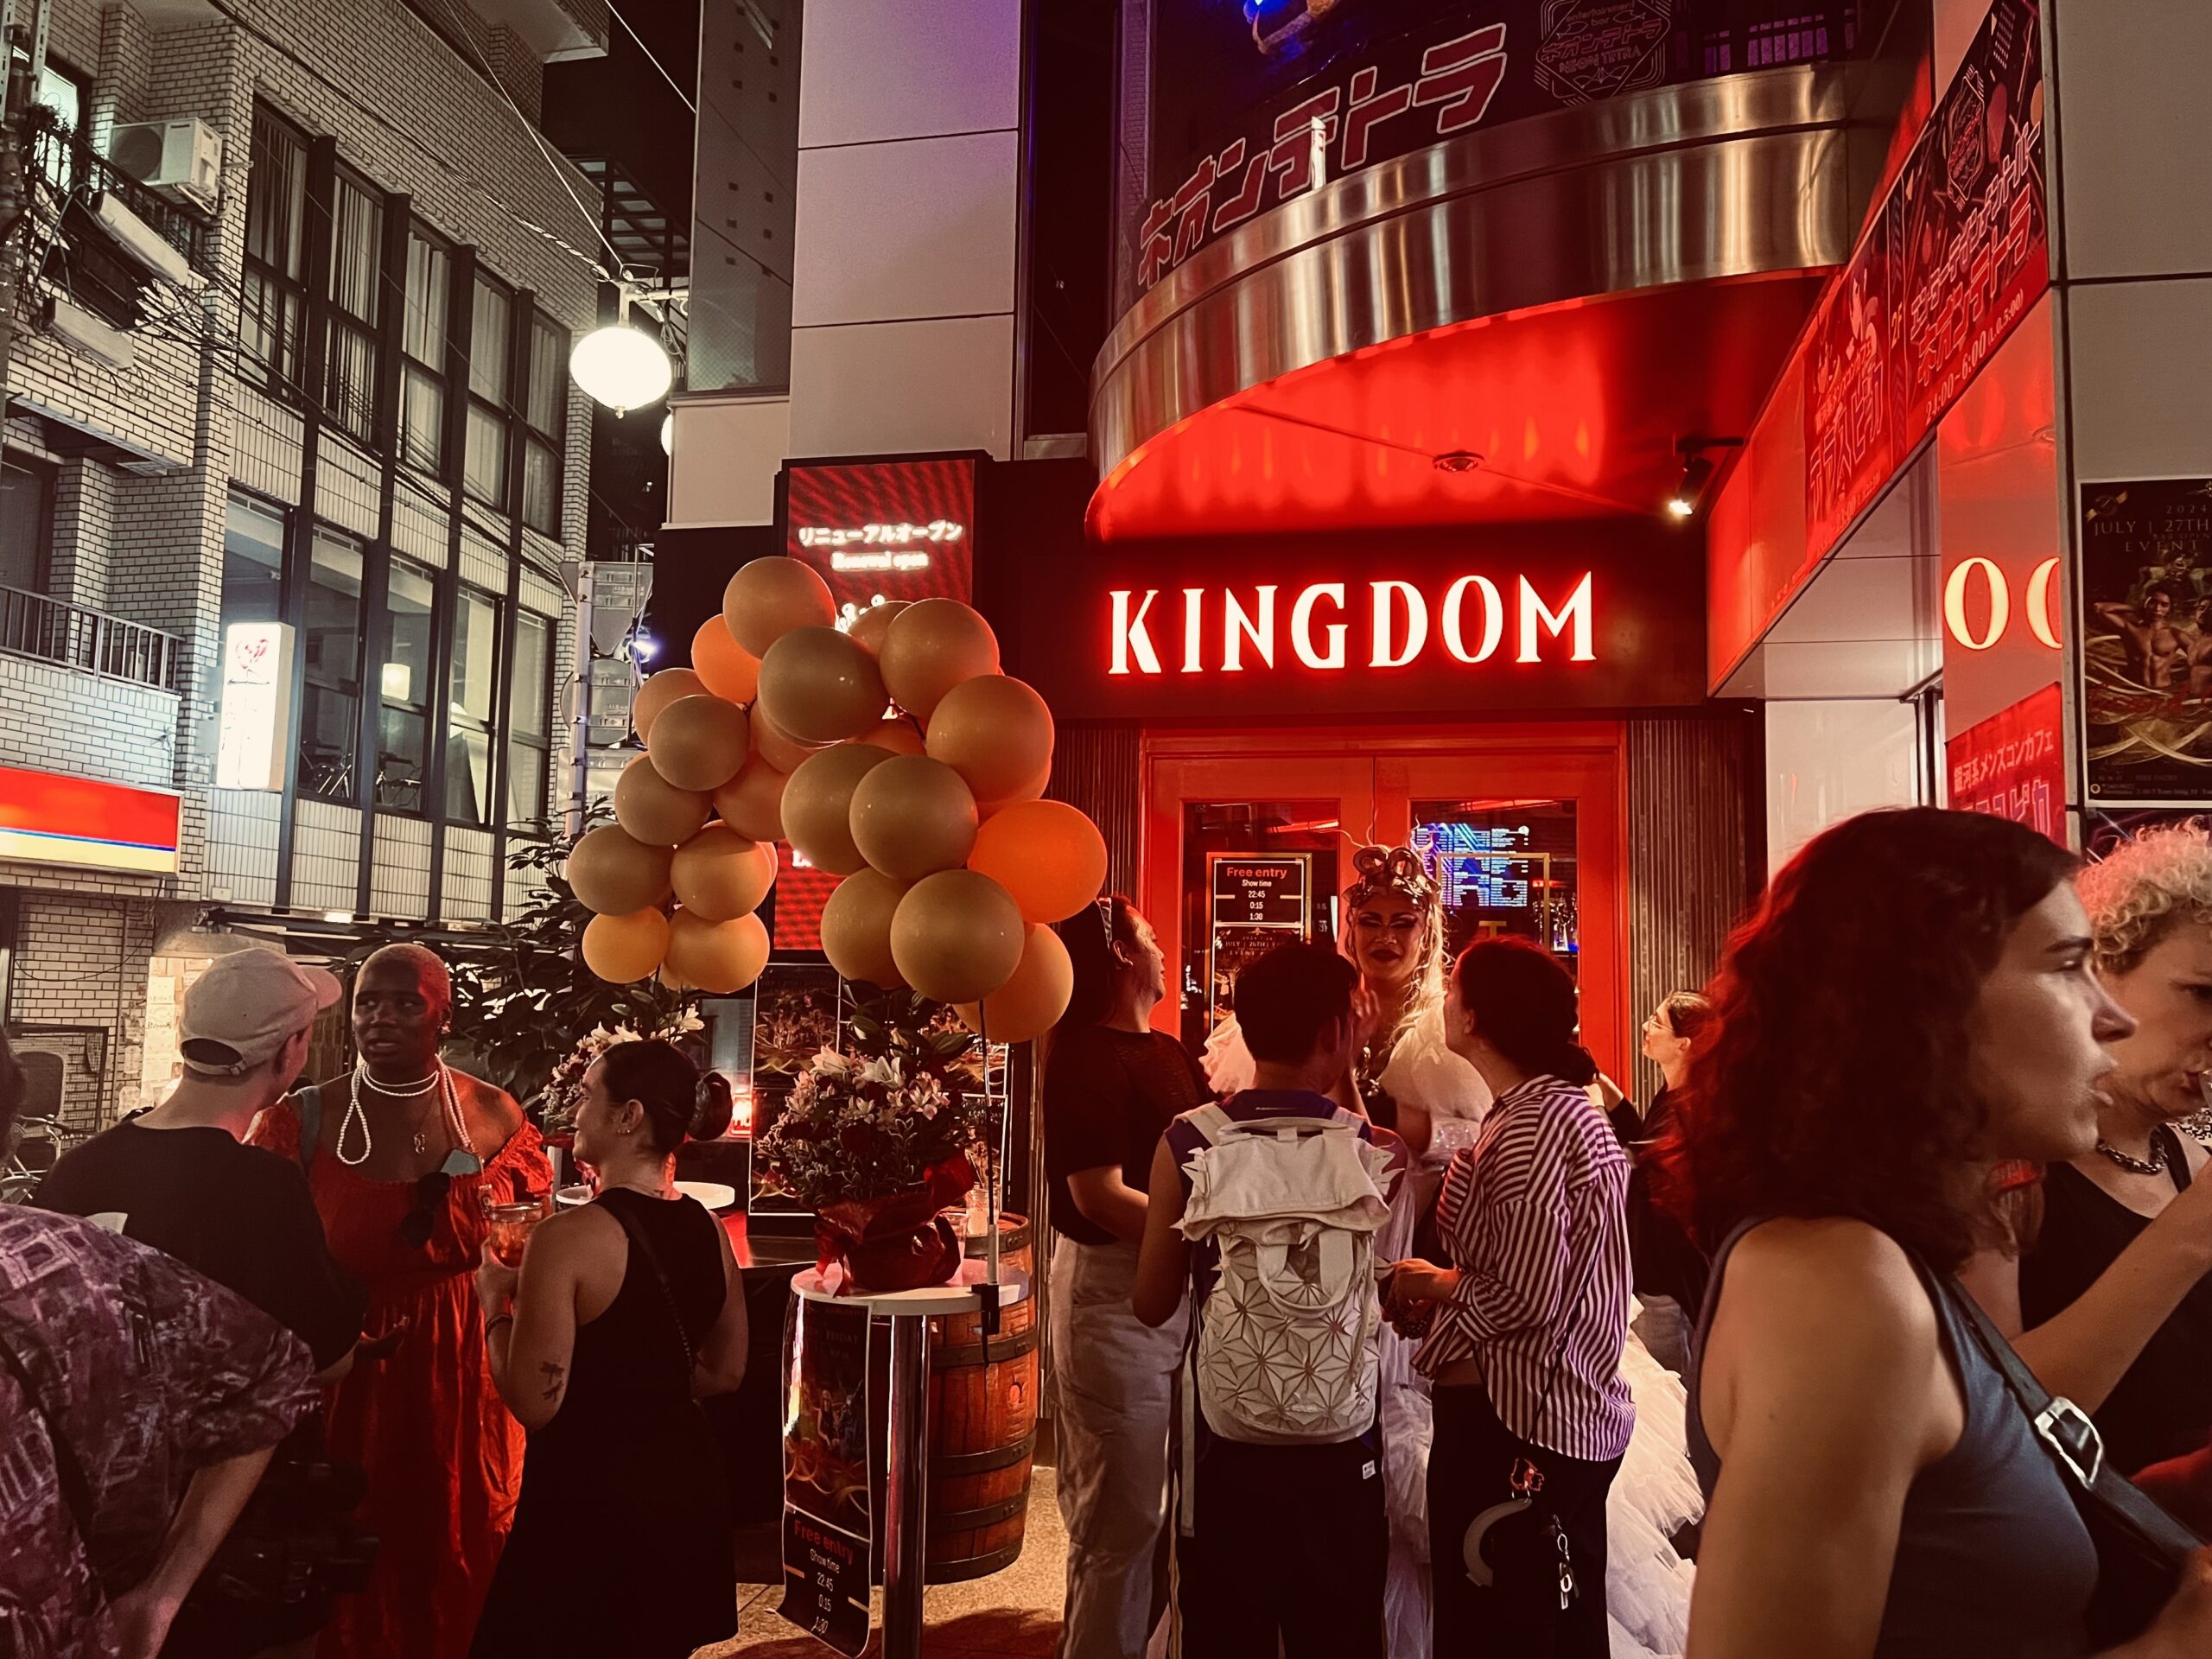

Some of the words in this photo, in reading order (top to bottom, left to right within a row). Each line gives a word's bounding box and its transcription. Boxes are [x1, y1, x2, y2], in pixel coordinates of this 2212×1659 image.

[1541, 18, 1662, 63] ネオンテトラ
[1559, 54, 1599, 73] NEON
[1600, 45, 1642, 65] TETRA
[1138, 22, 1508, 289] ネオンテトラ
[1917, 181, 2031, 387] ネオンテトラ
[1891, 302, 1903, 350] 2F
[798, 519, 963, 548] リニューアルオープン
[2094, 520, 2136, 536] JULY
[2165, 518, 2209, 532] 27TH
[2126, 539, 2197, 552] EVENT
[1109, 570, 1597, 675] KINGDOM
[1226, 867, 1253, 877] Free
[1255, 868, 1287, 880] entry
[1242, 879, 1258, 887] Show
[1248, 890, 1266, 899] 22:45
[1249, 901, 1263, 910] 0:15
[1249, 912, 1263, 921] 1:30
[794, 1520, 820, 1545] Free
[823, 1535, 854, 1566] entry
[810, 1548, 827, 1564] Show
[827, 1557, 840, 1574] time
[817, 1572, 834, 1592] 22:45
[818, 1593, 831, 1612] 0:15
[810, 1615, 829, 1634] 1:30
